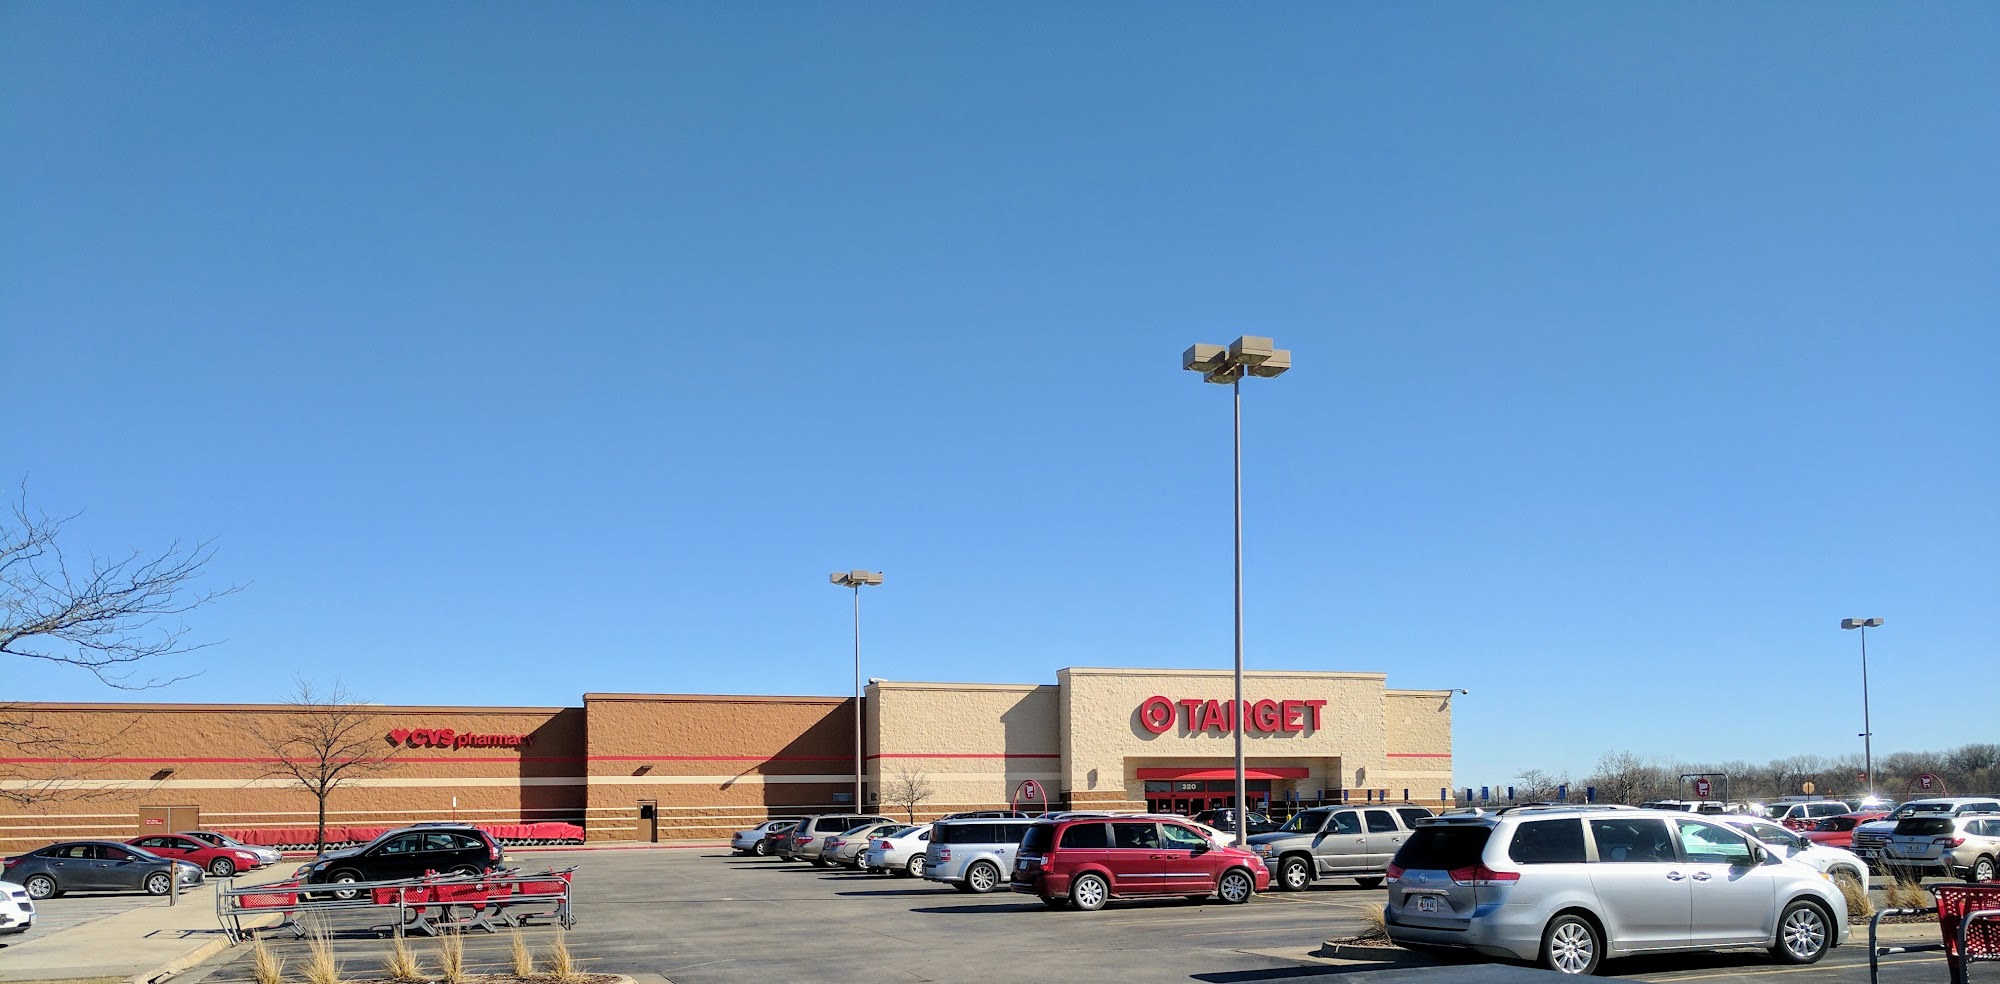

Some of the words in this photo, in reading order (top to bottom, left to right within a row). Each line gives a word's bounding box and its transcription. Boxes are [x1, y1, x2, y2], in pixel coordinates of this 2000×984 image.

[1180, 699, 1327, 732] TARGET
[411, 728, 455, 745] CVS
[458, 732, 535, 747] pharmacy
